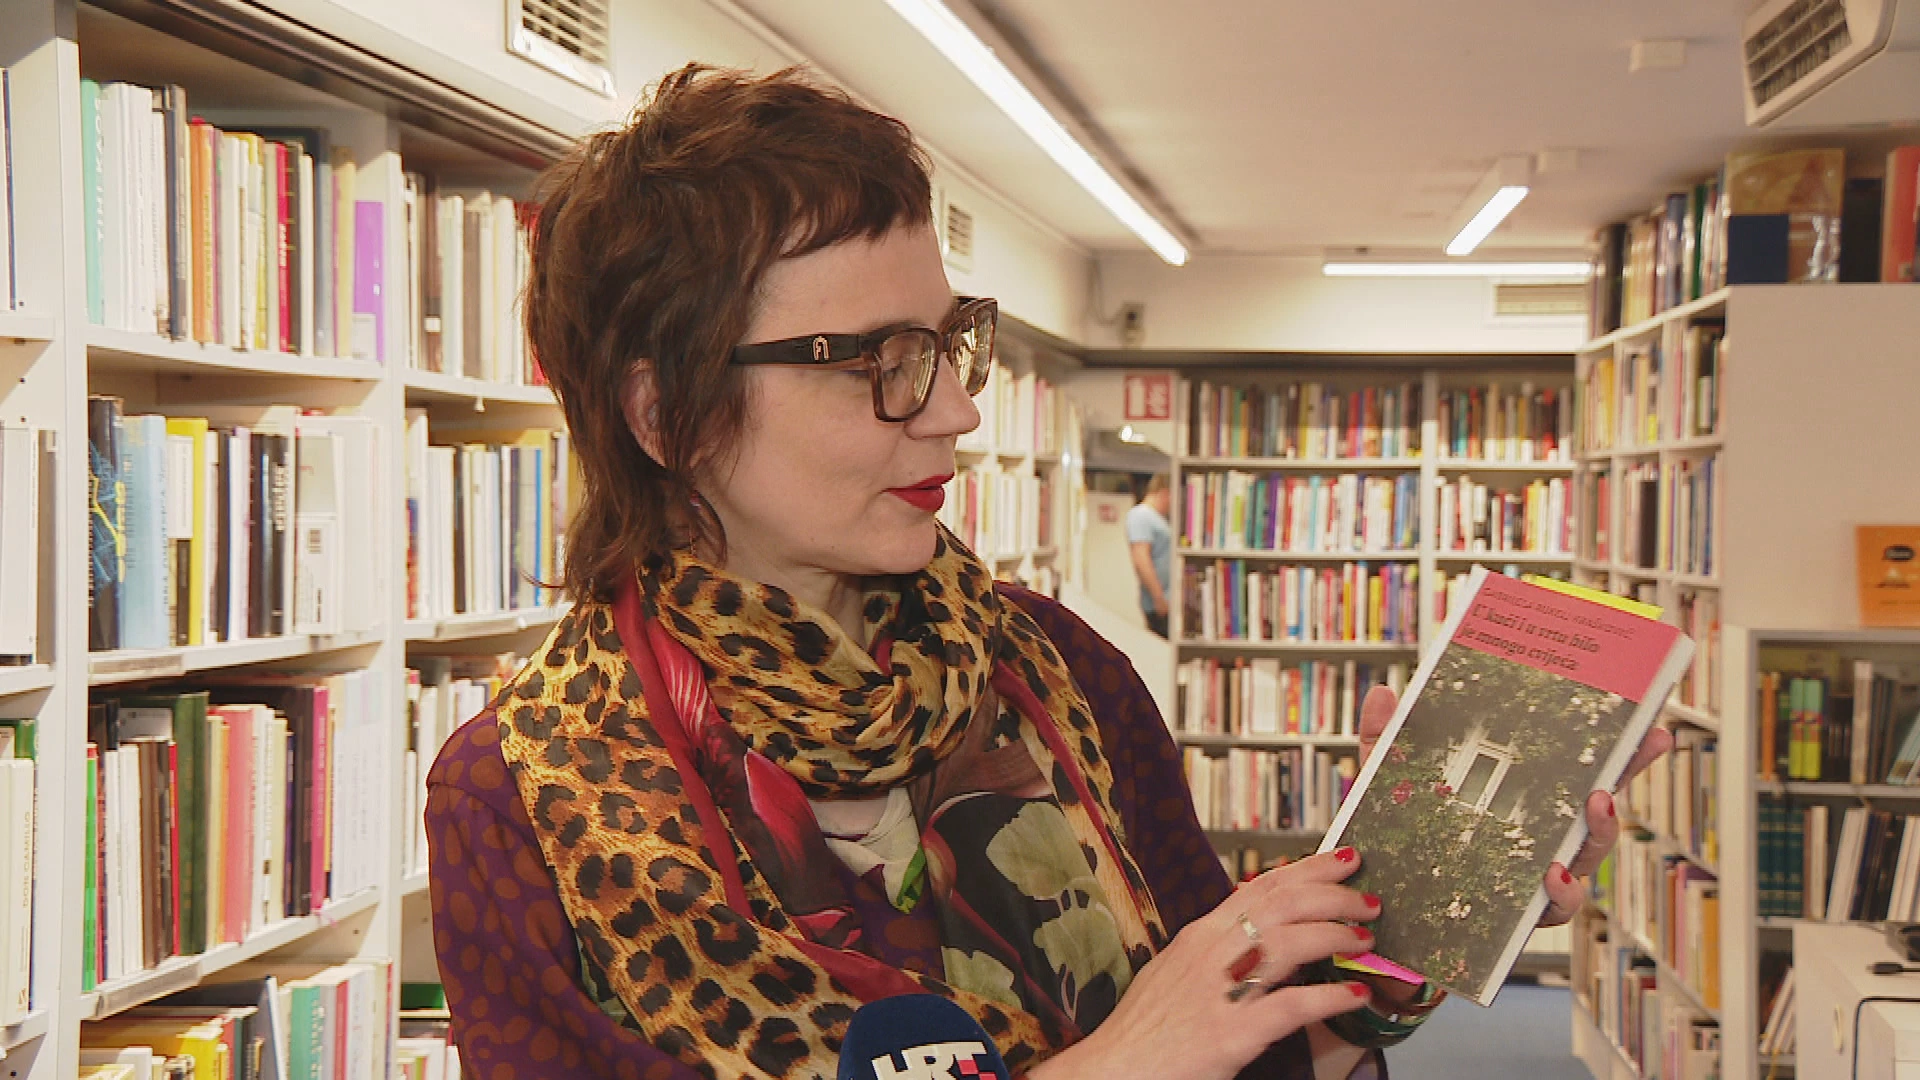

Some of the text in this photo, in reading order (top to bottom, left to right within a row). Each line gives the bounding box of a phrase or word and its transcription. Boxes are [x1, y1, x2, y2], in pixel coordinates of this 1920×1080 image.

[1456, 624, 1579, 670] je mnogo cvijeća
[1485, 607, 1518, 628] kući
[1525, 623, 1538, 635] u
[1538, 627, 1569, 645] vrtu
[1569, 633, 1601, 653] bilo
